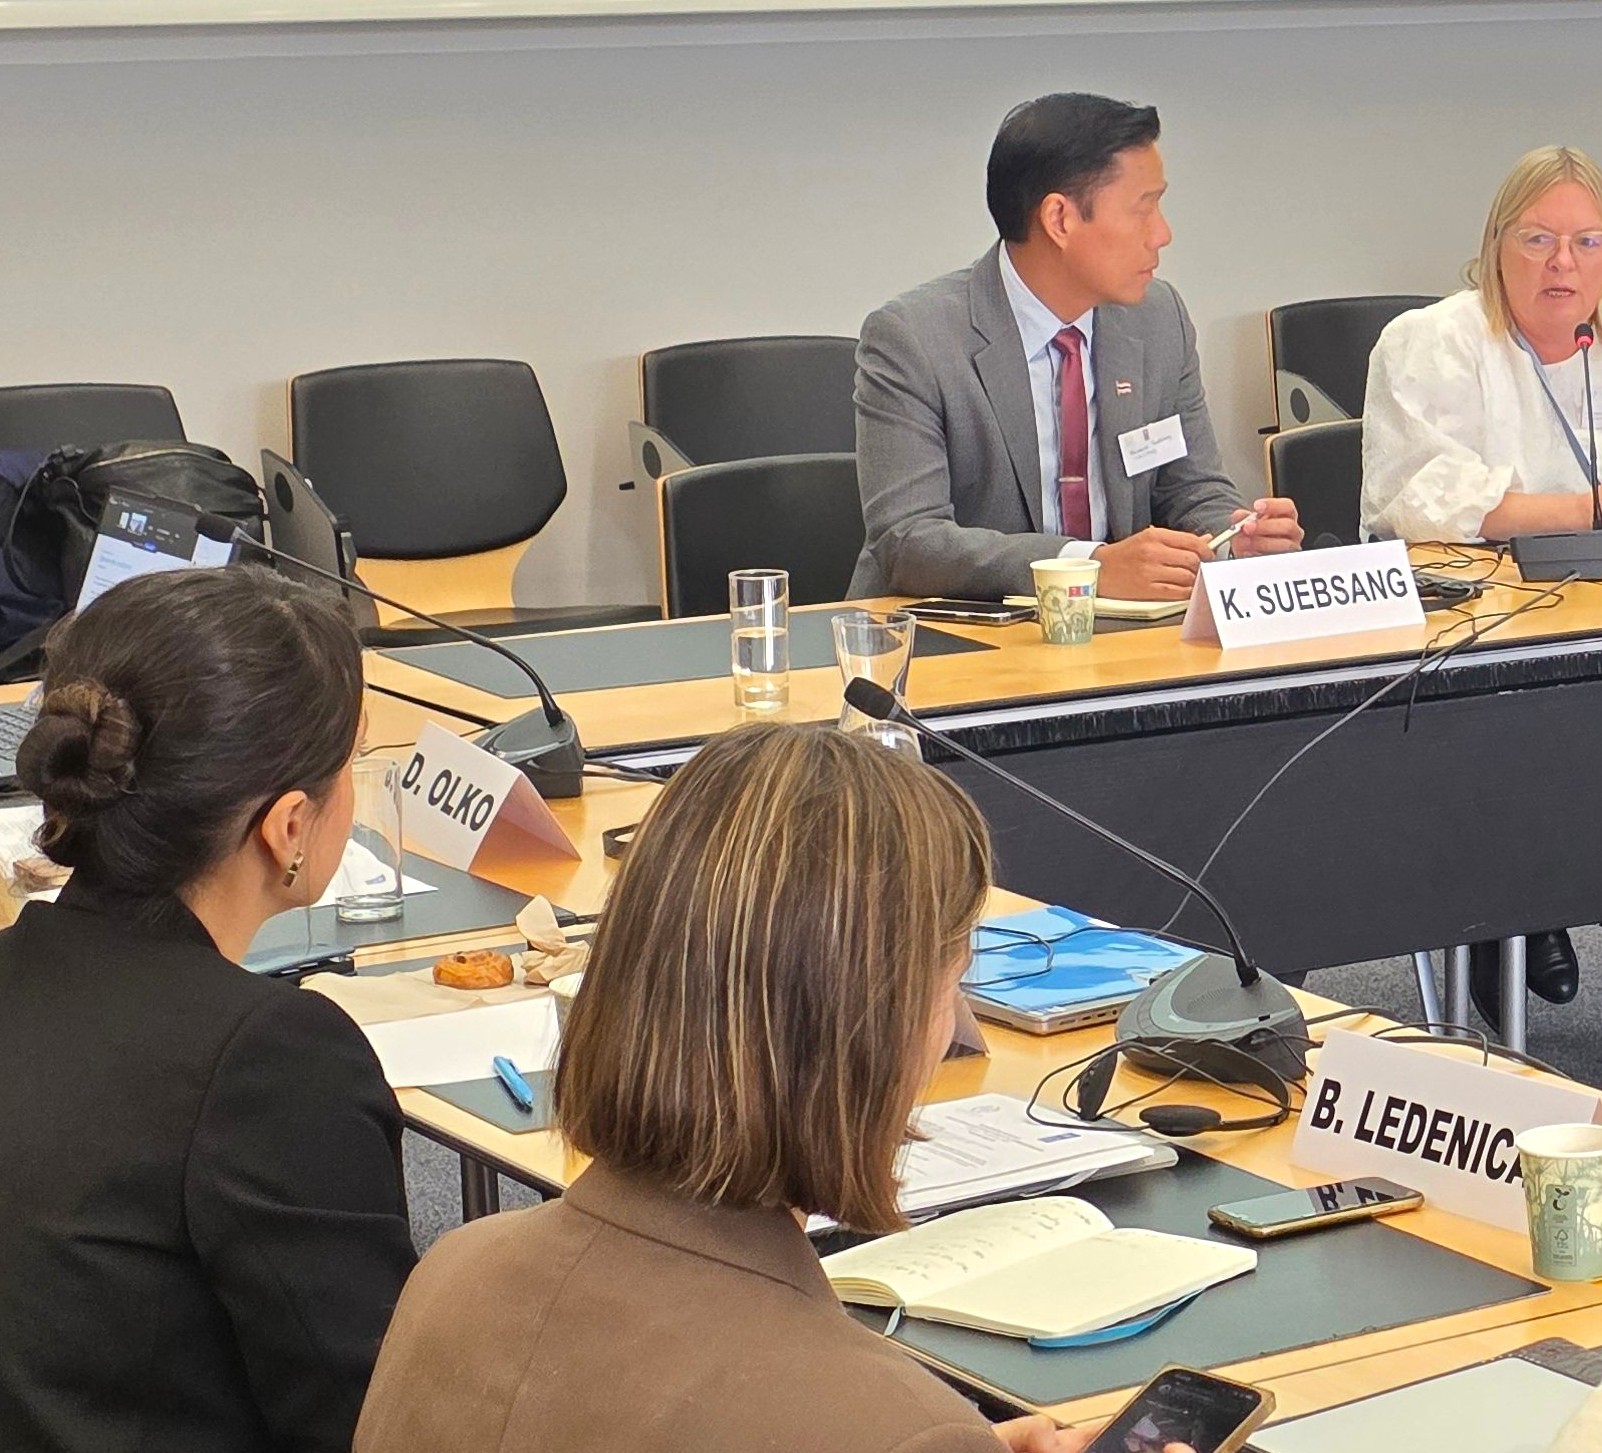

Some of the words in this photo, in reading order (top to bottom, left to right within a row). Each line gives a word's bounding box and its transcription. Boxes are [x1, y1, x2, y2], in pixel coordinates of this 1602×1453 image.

[1219, 588, 1251, 620] K.
[1256, 567, 1409, 615] SUEBSANG
[401, 752, 425, 796] D.
[428, 769, 495, 832] OLKO
[1310, 1078, 1344, 1134] B.
